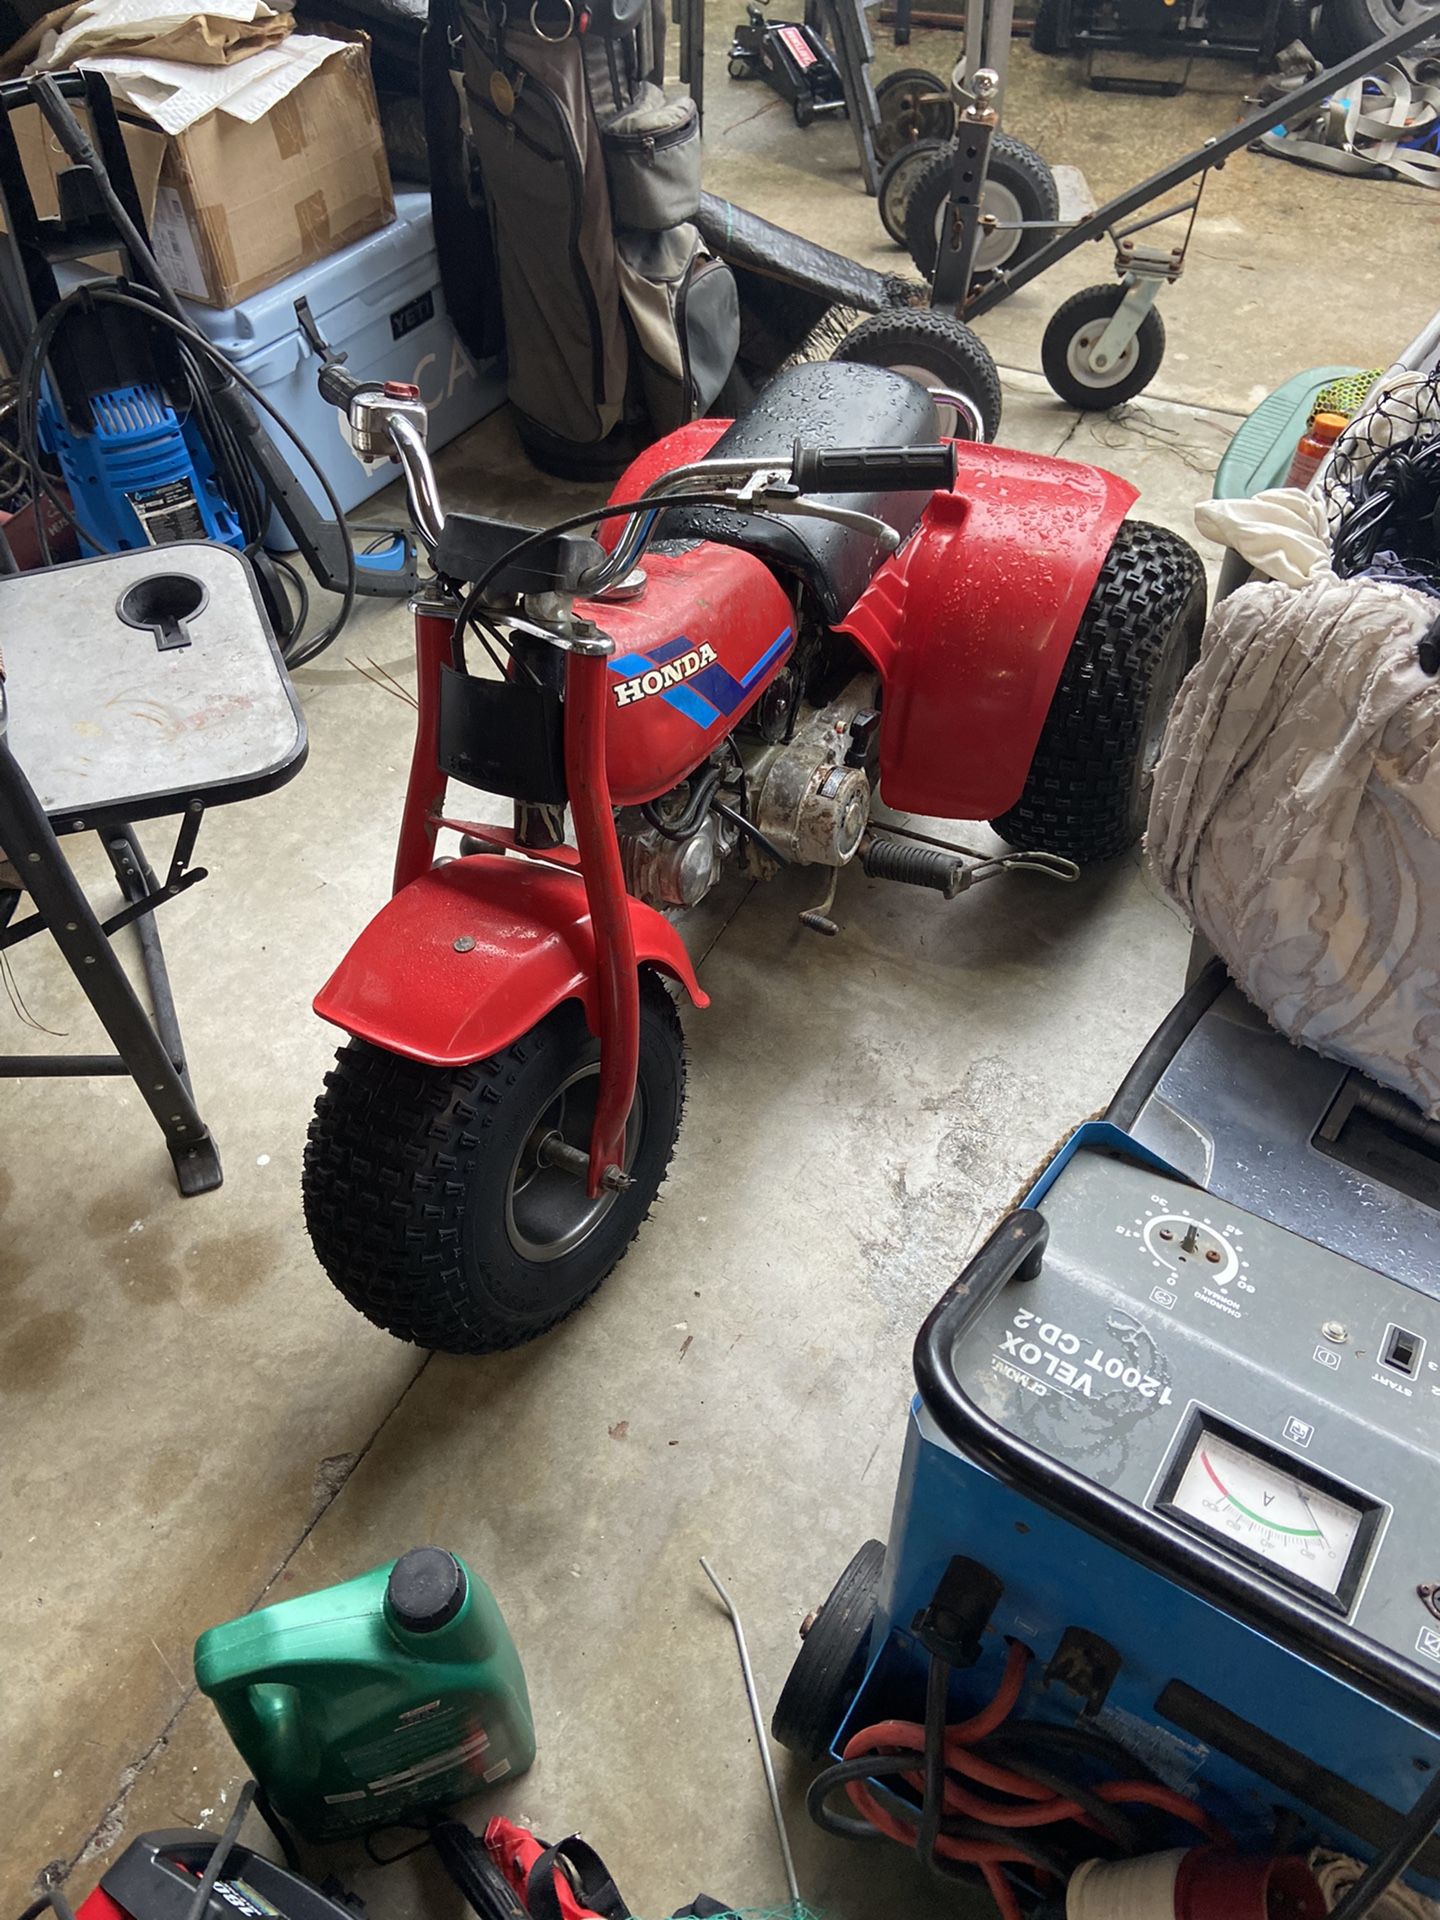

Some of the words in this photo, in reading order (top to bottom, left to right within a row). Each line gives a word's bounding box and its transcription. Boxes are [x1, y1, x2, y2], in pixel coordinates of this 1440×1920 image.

[392, 301, 431, 333] YETI
[613, 642, 718, 708] HONDA
[1151, 1194, 1168, 1207] 30
[1115, 1225, 1132, 1238] 15
[1225, 1224, 1243, 1236] 45
[1202, 1286, 1240, 1310] NORMAL
[1237, 1280, 1256, 1294] 60
[1194, 1291, 1242, 1319] CHARGING
[1013, 1307, 1081, 1355] CD.2
[999, 1330, 1093, 1398] VELOX
[1428, 1361, 1438, 1371] 3
[1084, 1349, 1173, 1406] 1200T
[1371, 1373, 1413, 1397] START
[1263, 1491, 1275, 1507] A
[213, 1881, 253, 1917] 180
